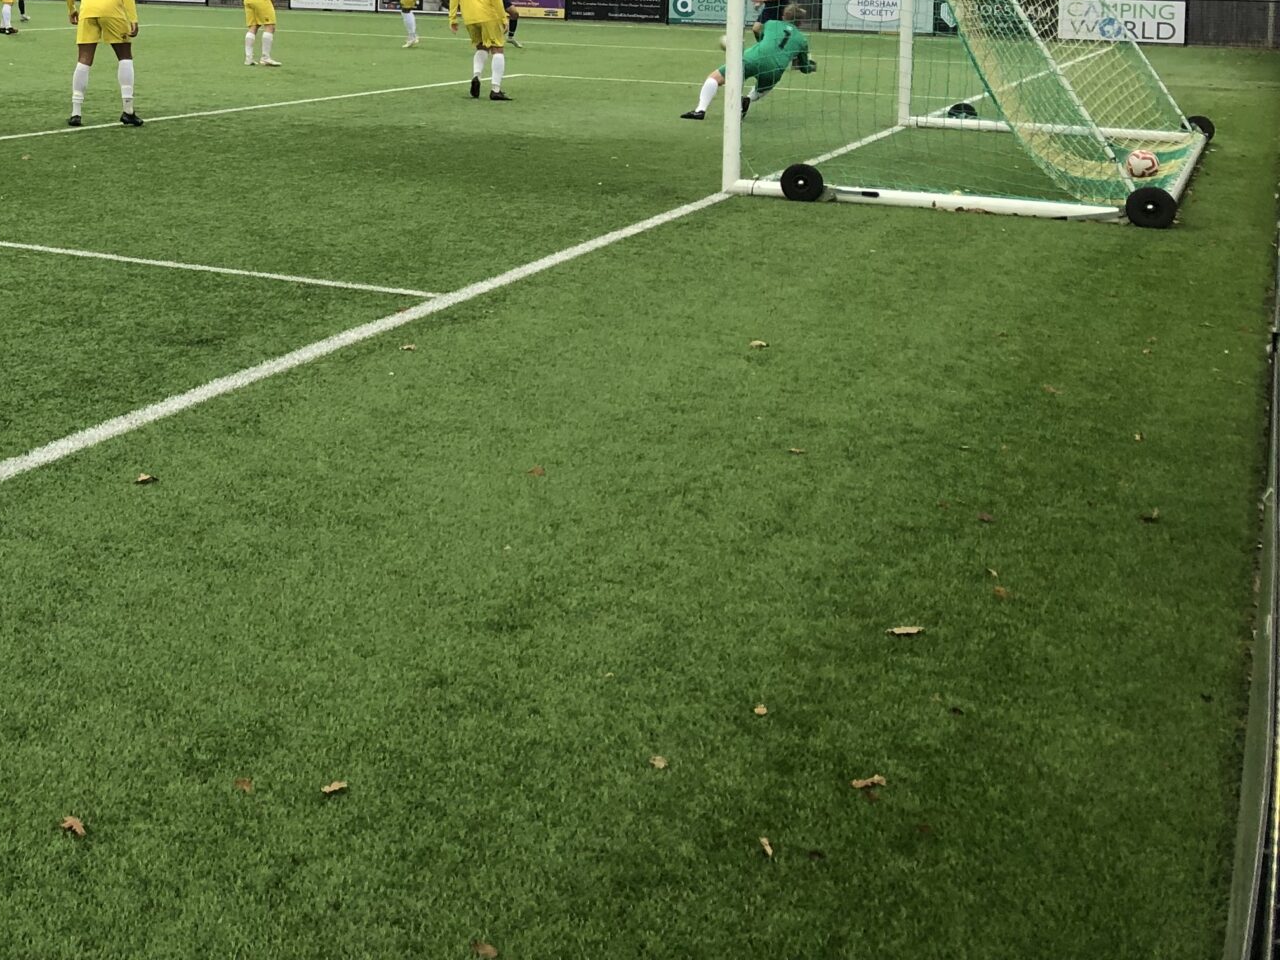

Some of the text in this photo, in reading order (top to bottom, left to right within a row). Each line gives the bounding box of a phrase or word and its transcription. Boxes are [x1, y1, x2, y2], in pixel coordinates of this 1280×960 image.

[698, 4, 726, 13] CRICK
[858, 0, 898, 8] HORSHAM
[1067, 2, 1176, 20] CAMPING
[1070, 20, 1176, 40] WORLD
[778, 30, 791, 50] 1
